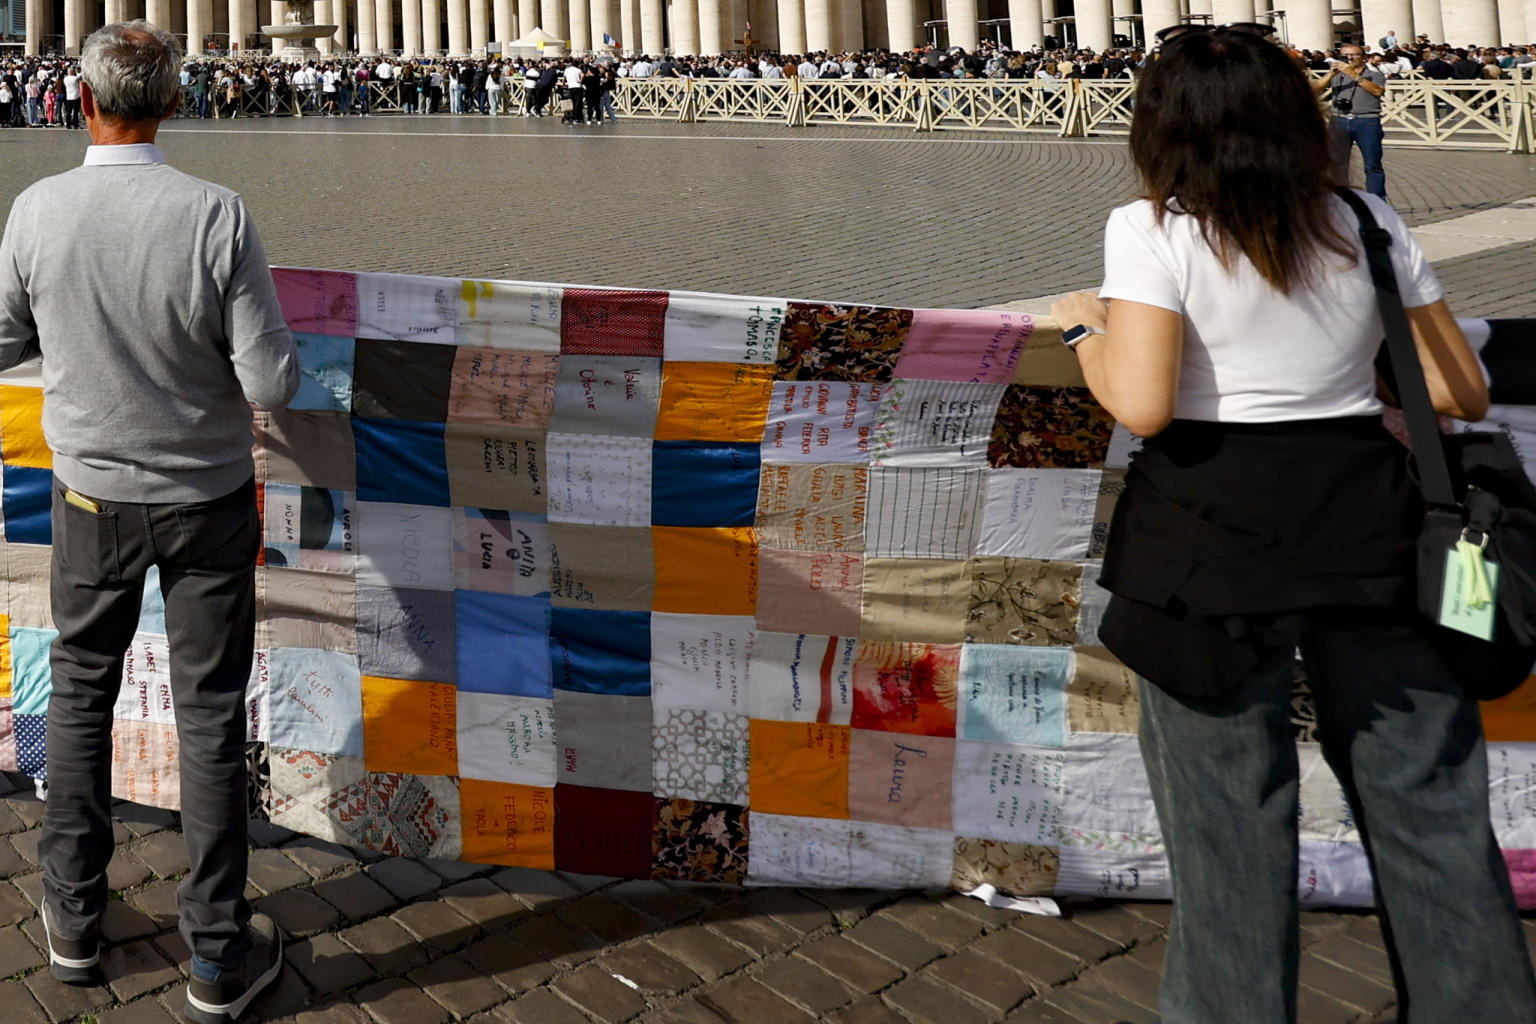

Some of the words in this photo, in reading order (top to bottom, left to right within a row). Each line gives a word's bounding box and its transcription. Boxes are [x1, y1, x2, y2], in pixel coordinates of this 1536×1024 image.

[816, 427, 830, 447] RITA
[480, 533, 493, 570] LUCIA
[516, 529, 536, 577] ANITA
[398, 604, 435, 655] ANNA
[256, 651, 268, 683] AGATA
[888, 743, 928, 804] Laura
[476, 808, 487, 838] PAOLA
